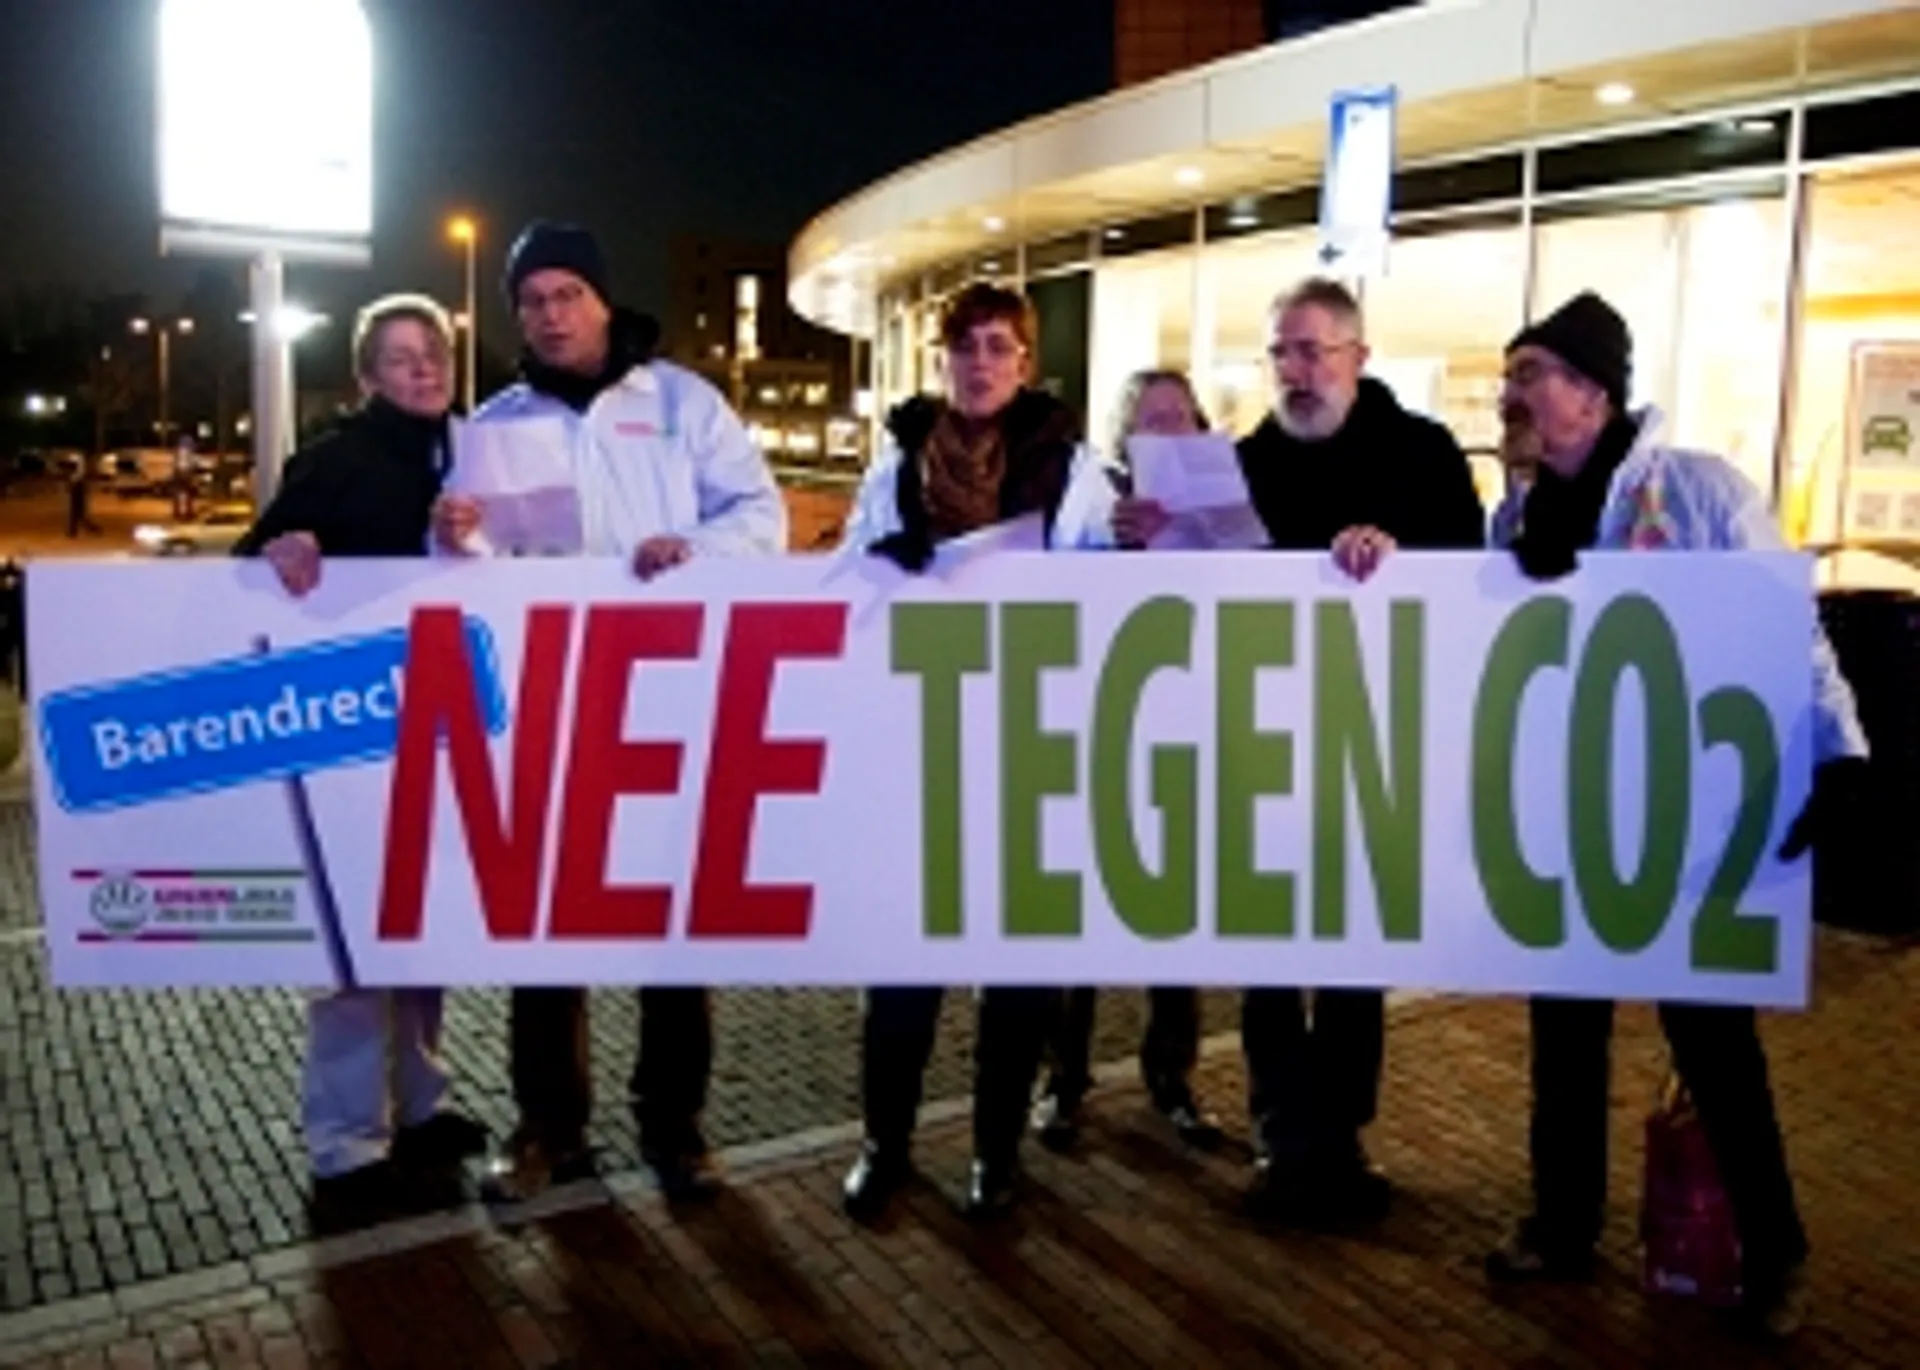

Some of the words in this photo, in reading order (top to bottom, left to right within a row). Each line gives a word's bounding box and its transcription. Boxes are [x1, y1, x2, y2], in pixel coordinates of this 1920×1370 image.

[376, 602, 849, 942] NEE
[889, 595, 1426, 942] TEGEN
[1469, 593, 1781, 975] CO2
